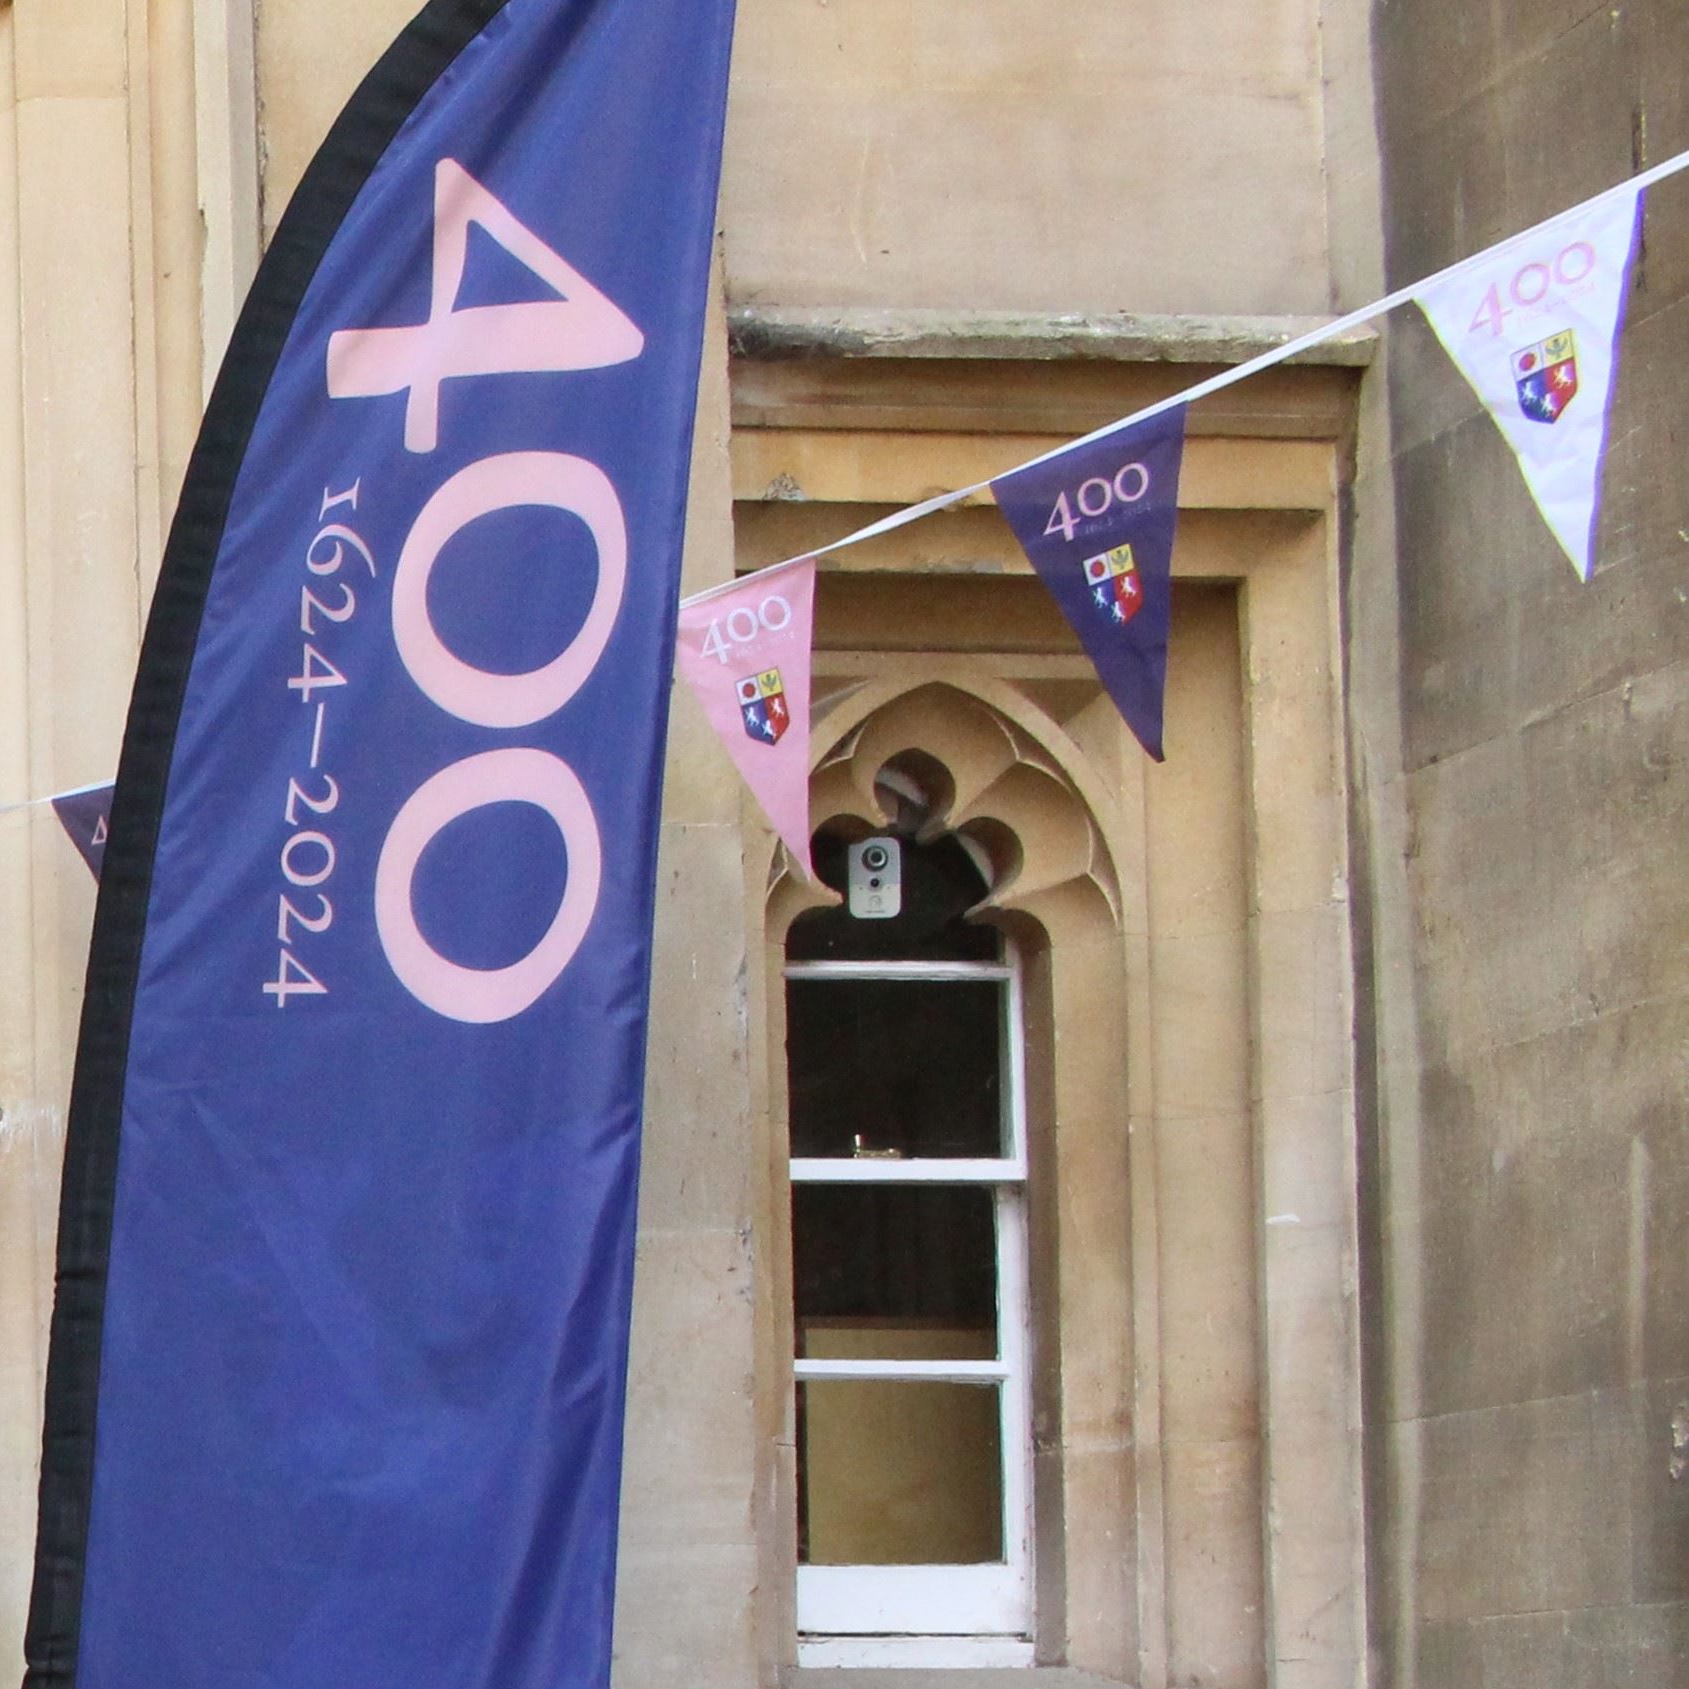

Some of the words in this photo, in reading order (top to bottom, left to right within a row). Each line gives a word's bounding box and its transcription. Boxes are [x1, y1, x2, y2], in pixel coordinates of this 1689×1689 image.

[1468, 239, 1596, 337] 400
[1042, 462, 1149, 542] 400
[326, 157, 644, 1023] 400
[700, 595, 791, 664] 400
